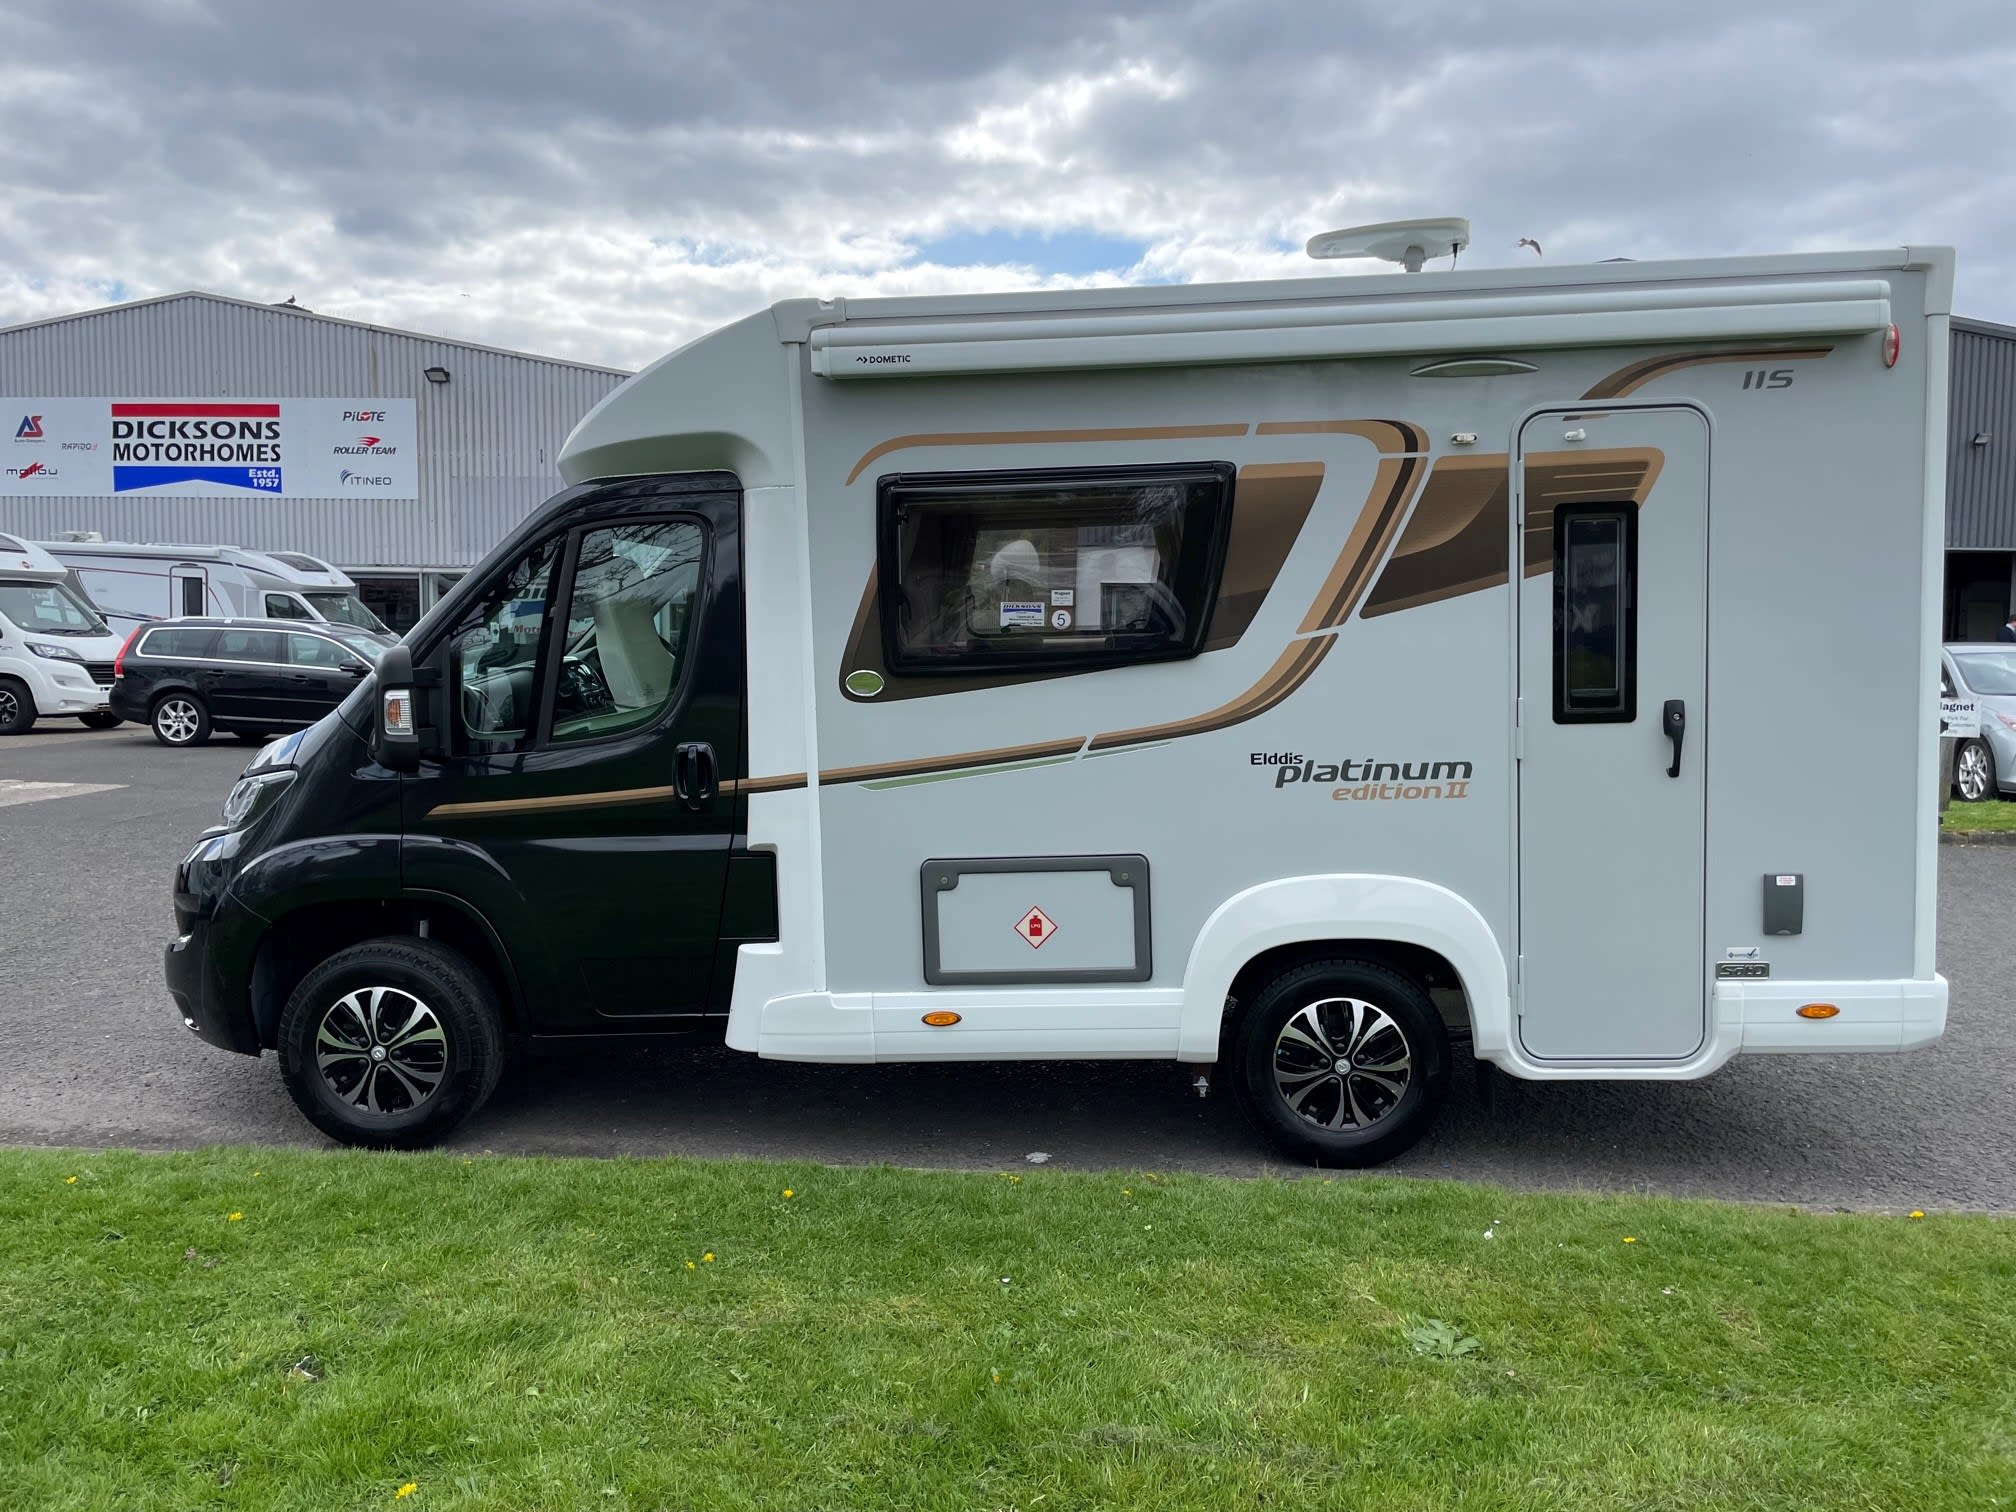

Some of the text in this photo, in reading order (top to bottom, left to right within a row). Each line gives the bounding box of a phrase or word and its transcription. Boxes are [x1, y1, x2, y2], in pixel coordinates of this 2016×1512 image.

[869, 355, 911, 363] DOMETIC
[112, 421, 280, 440] DICKSONS
[113, 443, 281, 462] MOTORHOMES
[333, 447, 397, 455] ROLLER TEAM
[249, 469, 279, 478] Estd.
[253, 478, 279, 488] 1957
[1057, 613, 1066, 627] 5
[1940, 702, 1975, 712] agnet
[1250, 753, 1303, 765] Elddis
[1275, 759, 1472, 788] platinum
[1332, 783, 1442, 801] edition
